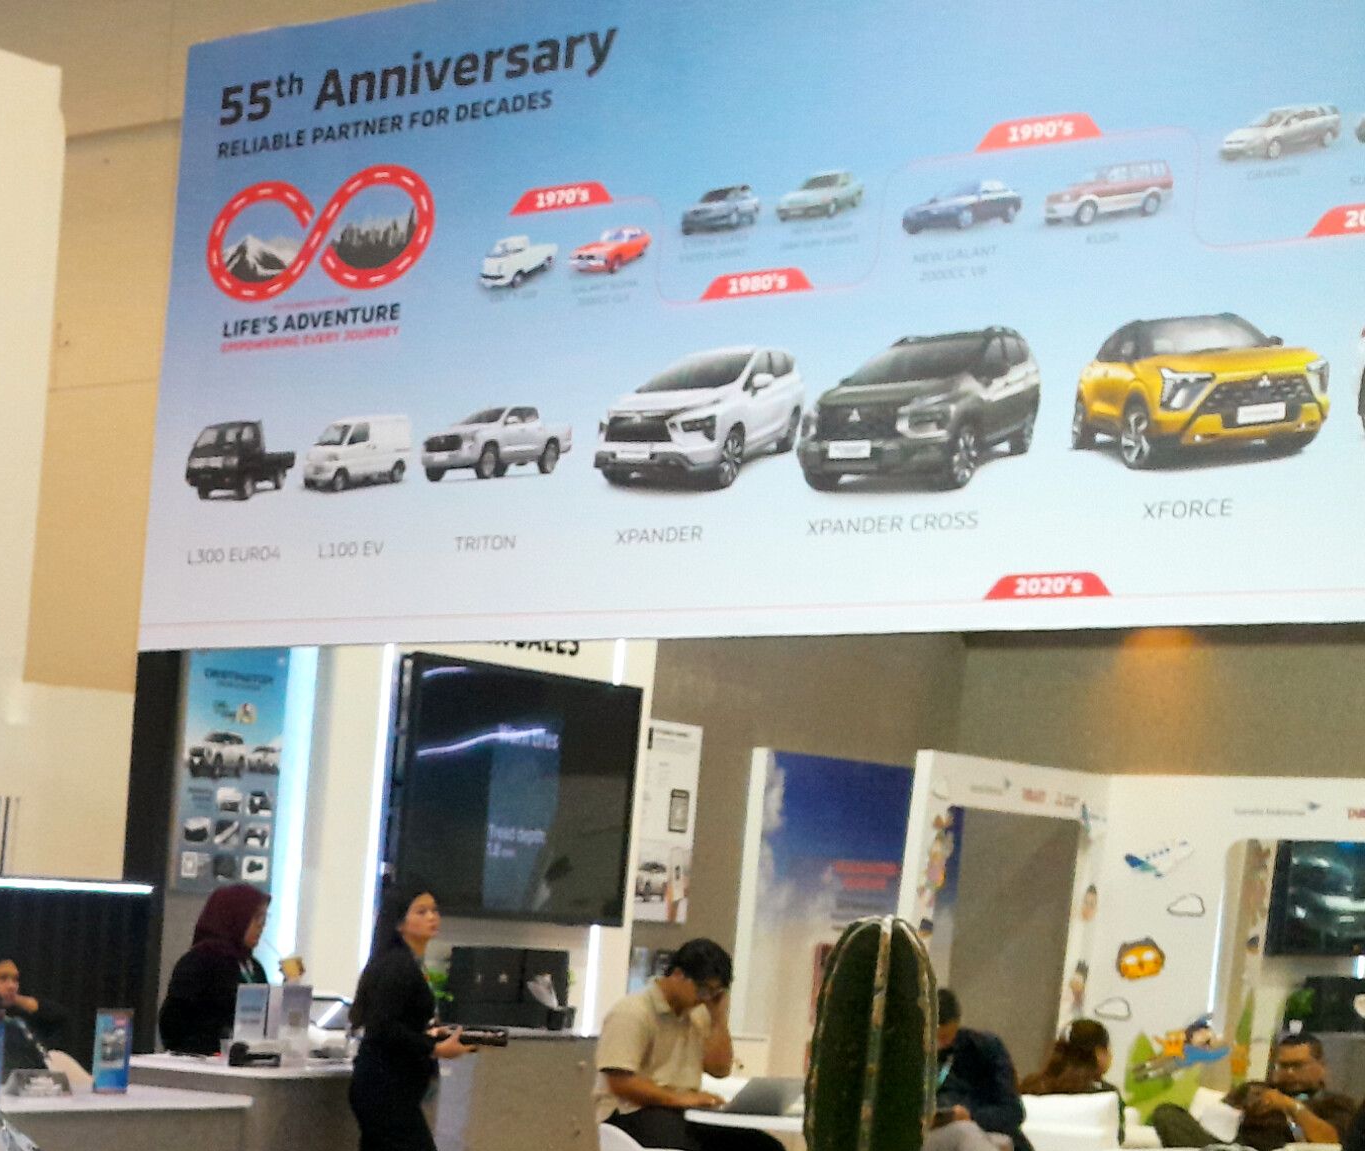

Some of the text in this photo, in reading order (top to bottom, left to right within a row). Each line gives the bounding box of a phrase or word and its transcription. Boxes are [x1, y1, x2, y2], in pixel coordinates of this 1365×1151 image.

[219, 26, 618, 127] 55th Anniversary
[217, 89, 553, 160] RELIABLE PARTNER FOR DECADES
[1007, 119, 1075, 144] 1990's
[535, 187, 590, 209] 1970's
[728, 274, 788, 295] 1980's
[222, 315, 278, 339] LIFE'S
[282, 302, 401, 332] ADVENTURE
[302, 332, 341, 345] EVERY
[344, 325, 400, 341] JOURNEY
[1141, 498, 1234, 522] XFORCE
[614, 523, 704, 546] XPANDER
[806, 511, 980, 538] XPANDER CROSS
[317, 540, 386, 560] L100 EV
[453, 533, 517, 553] TRITON
[186, 546, 282, 566] L300 EURO4
[1015, 574, 1084, 597] 2020's
